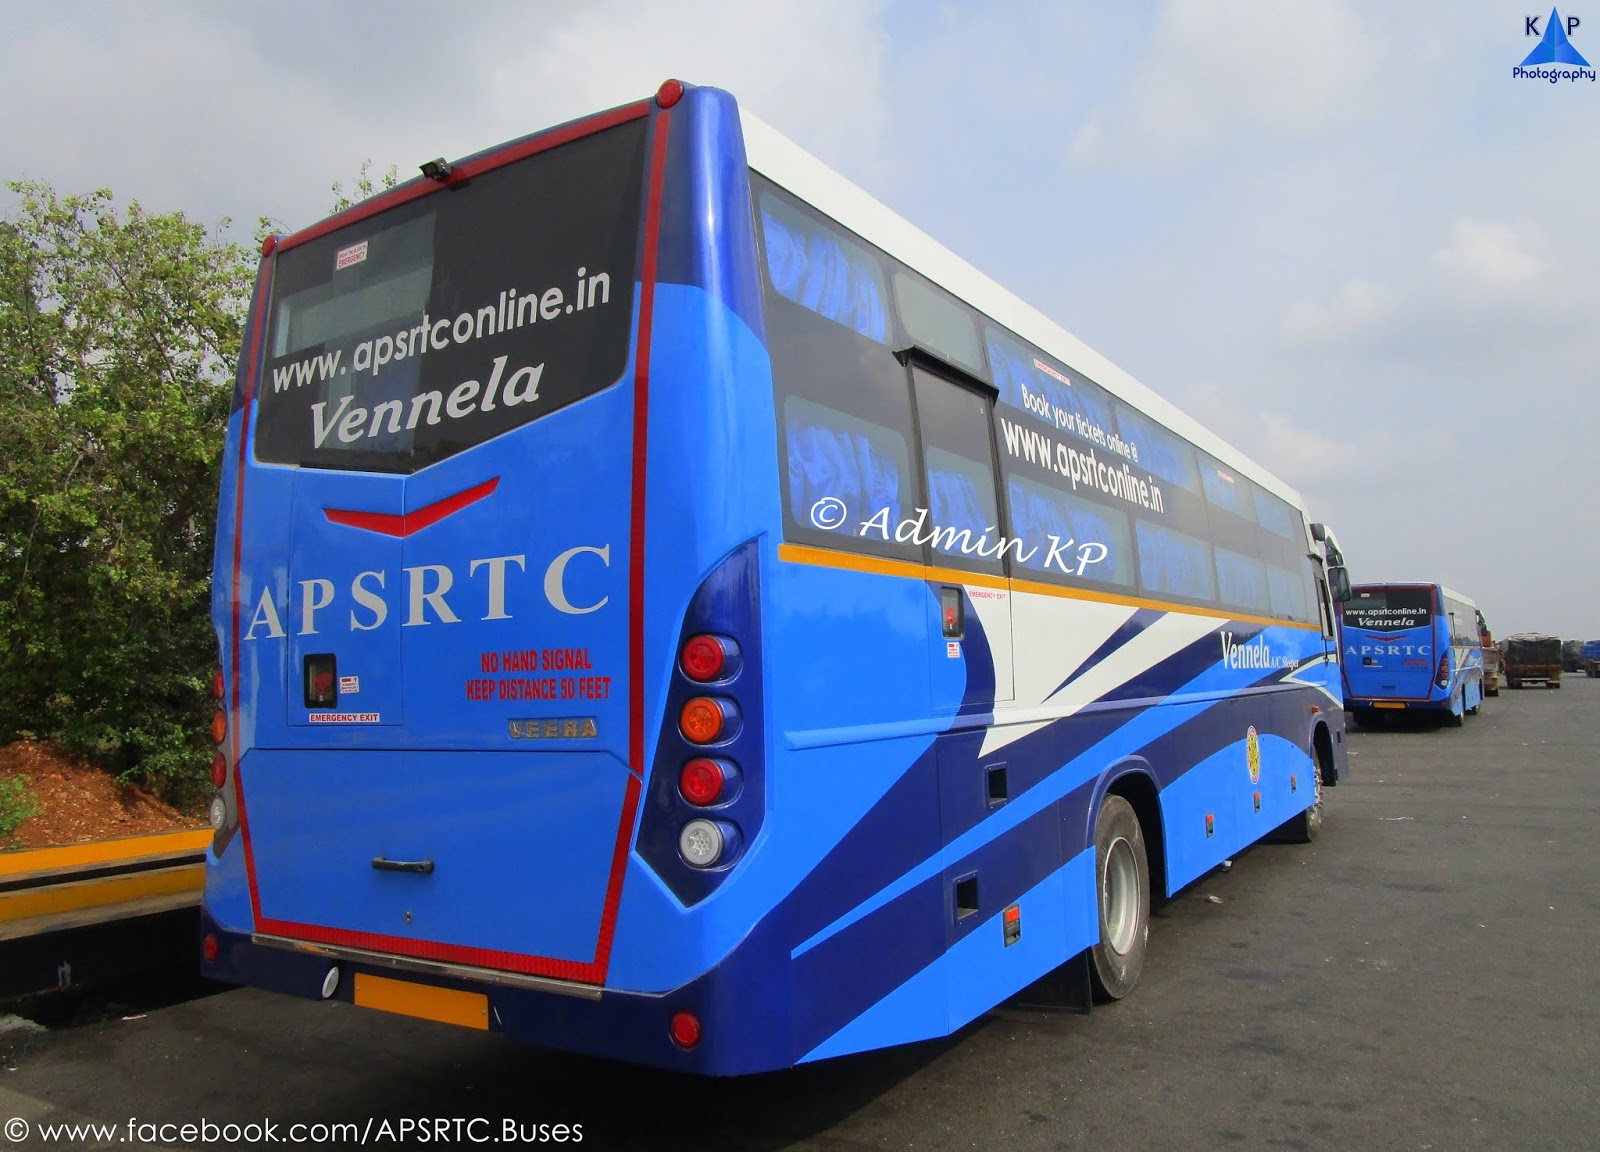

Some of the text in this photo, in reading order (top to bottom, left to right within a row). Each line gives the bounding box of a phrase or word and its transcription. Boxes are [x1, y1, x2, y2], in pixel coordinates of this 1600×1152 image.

[310, 354, 545, 449] Vennela
[1021, 382, 1052, 420] Book
[1052, 404, 1075, 429] your
[1075, 411, 1106, 447] tickets
[1106, 432, 1131, 460] online
[1000, 417, 1164, 514] www.apsrtconline.in
[243, 543, 611, 641] APSRTC
[968, 590, 997, 599] EMERGENCY
[1345, 607, 1427, 616] www.apsrtconline.in
[1358, 616, 1415, 626] Vennela
[481, 647, 593, 673] NO HAND SIGNAL
[1220, 630, 1270, 670] Vennela
[1345, 645, 1431, 656] APSRTC
[466, 676, 612, 701] KEEP DISTANCE 50 FEET
[310, 713, 379, 722] EMERGENCY EXIT
[508, 718, 598, 739] VEERA
